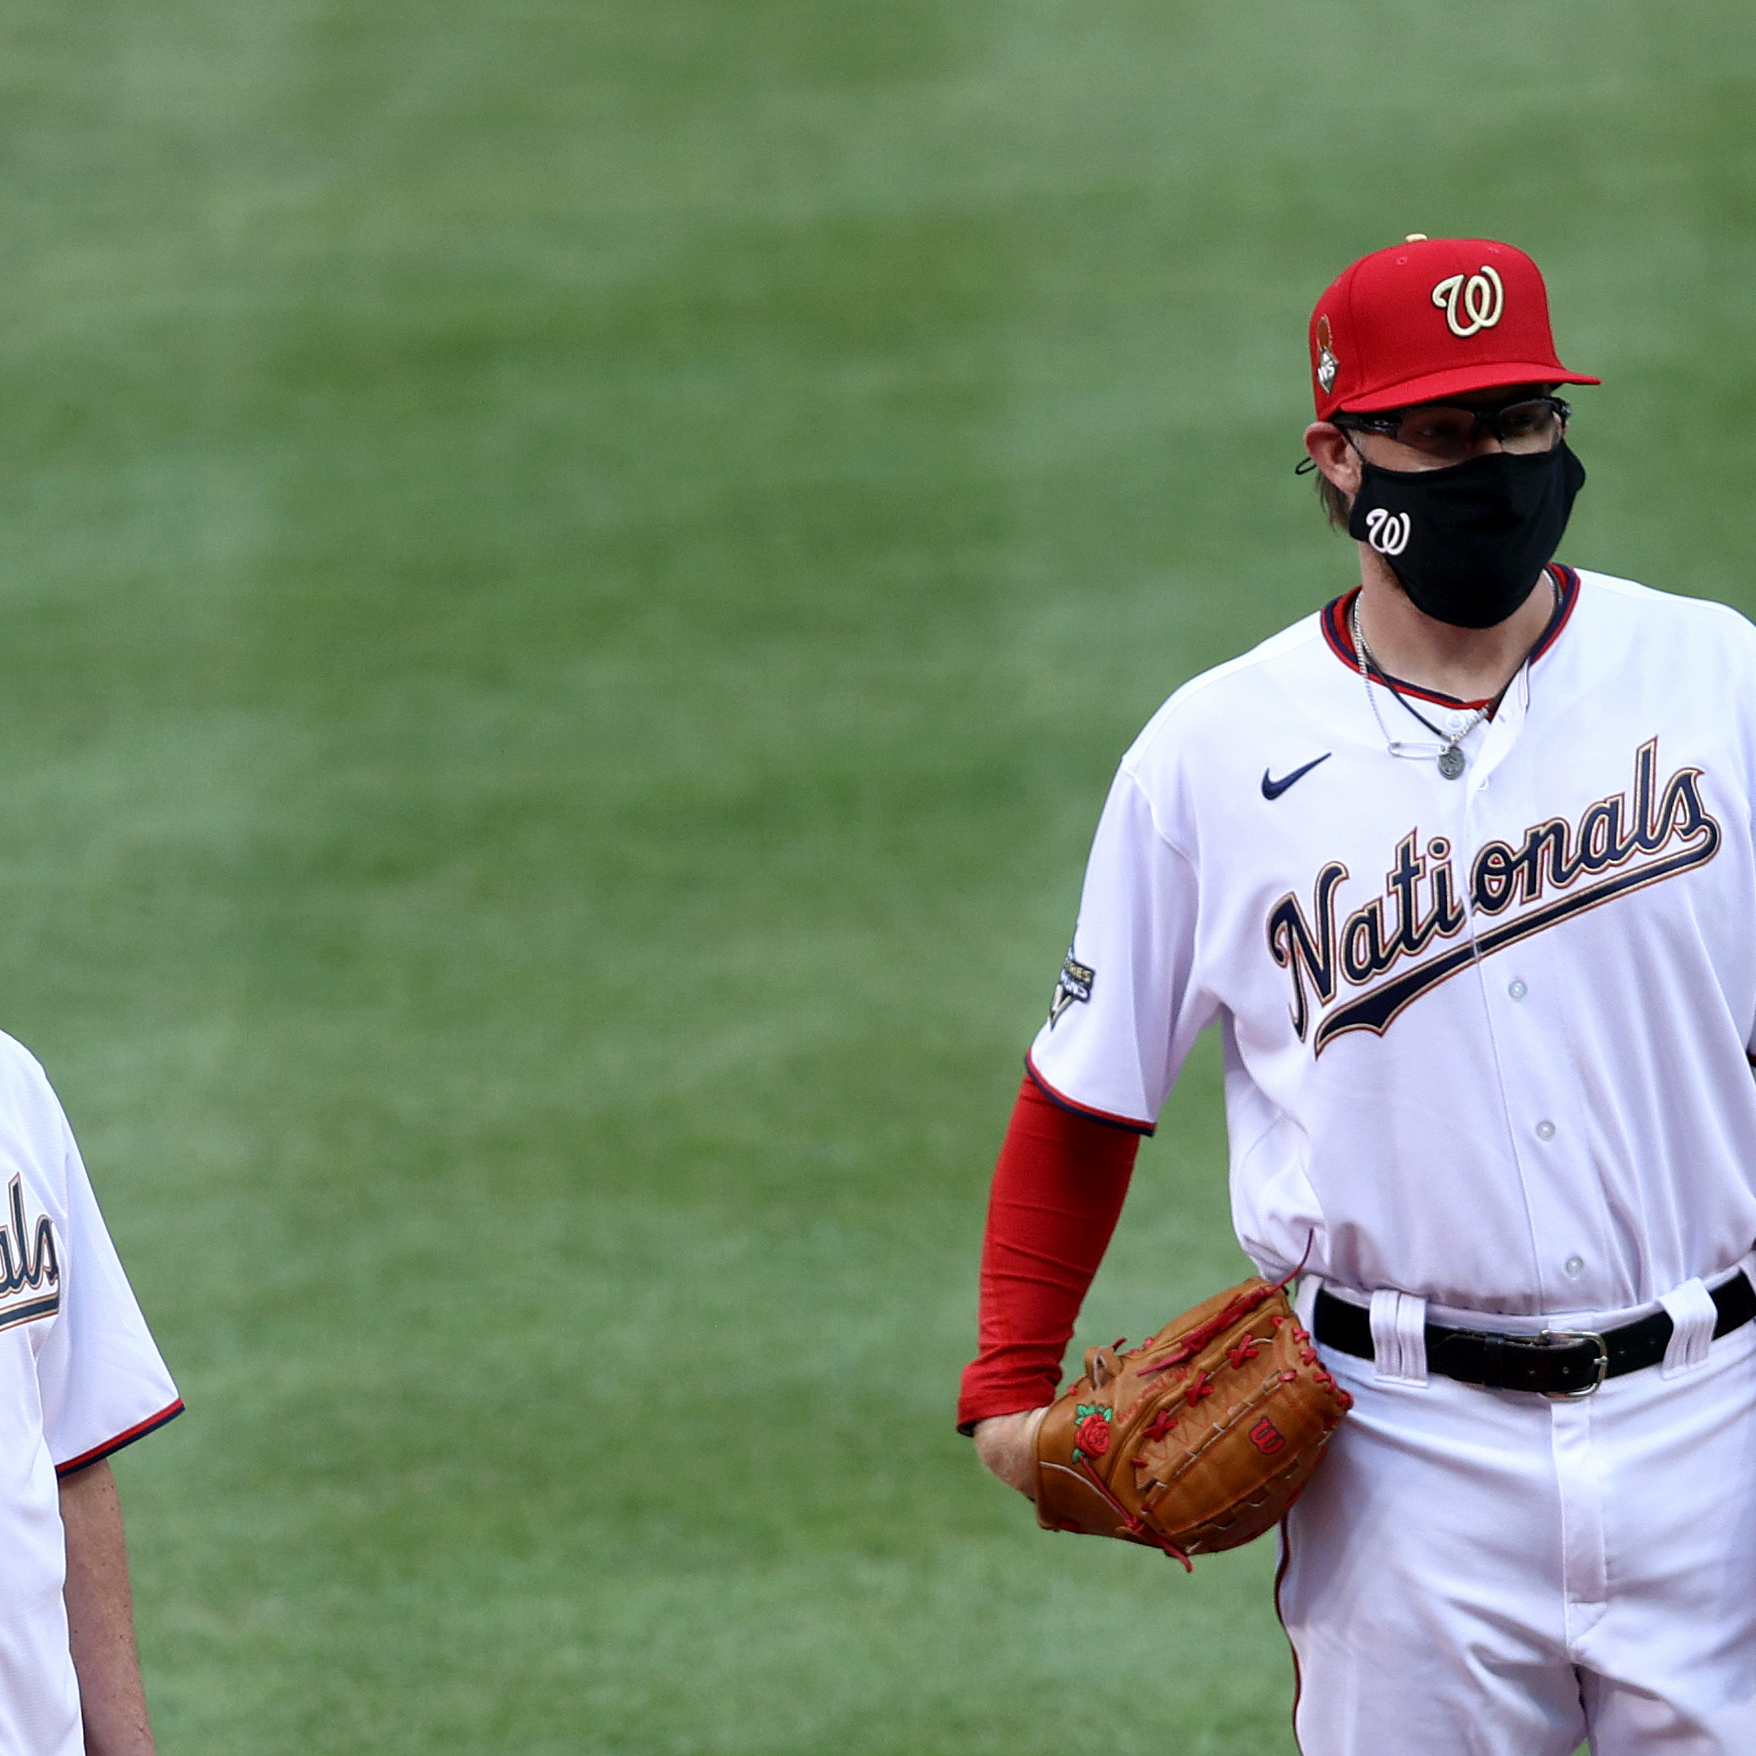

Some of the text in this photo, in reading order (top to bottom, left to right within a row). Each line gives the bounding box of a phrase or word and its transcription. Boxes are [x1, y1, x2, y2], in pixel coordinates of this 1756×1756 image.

[1431, 265, 1505, 338] W
[1365, 508, 1411, 556] W
[1265, 735, 1721, 1045] Nationals
